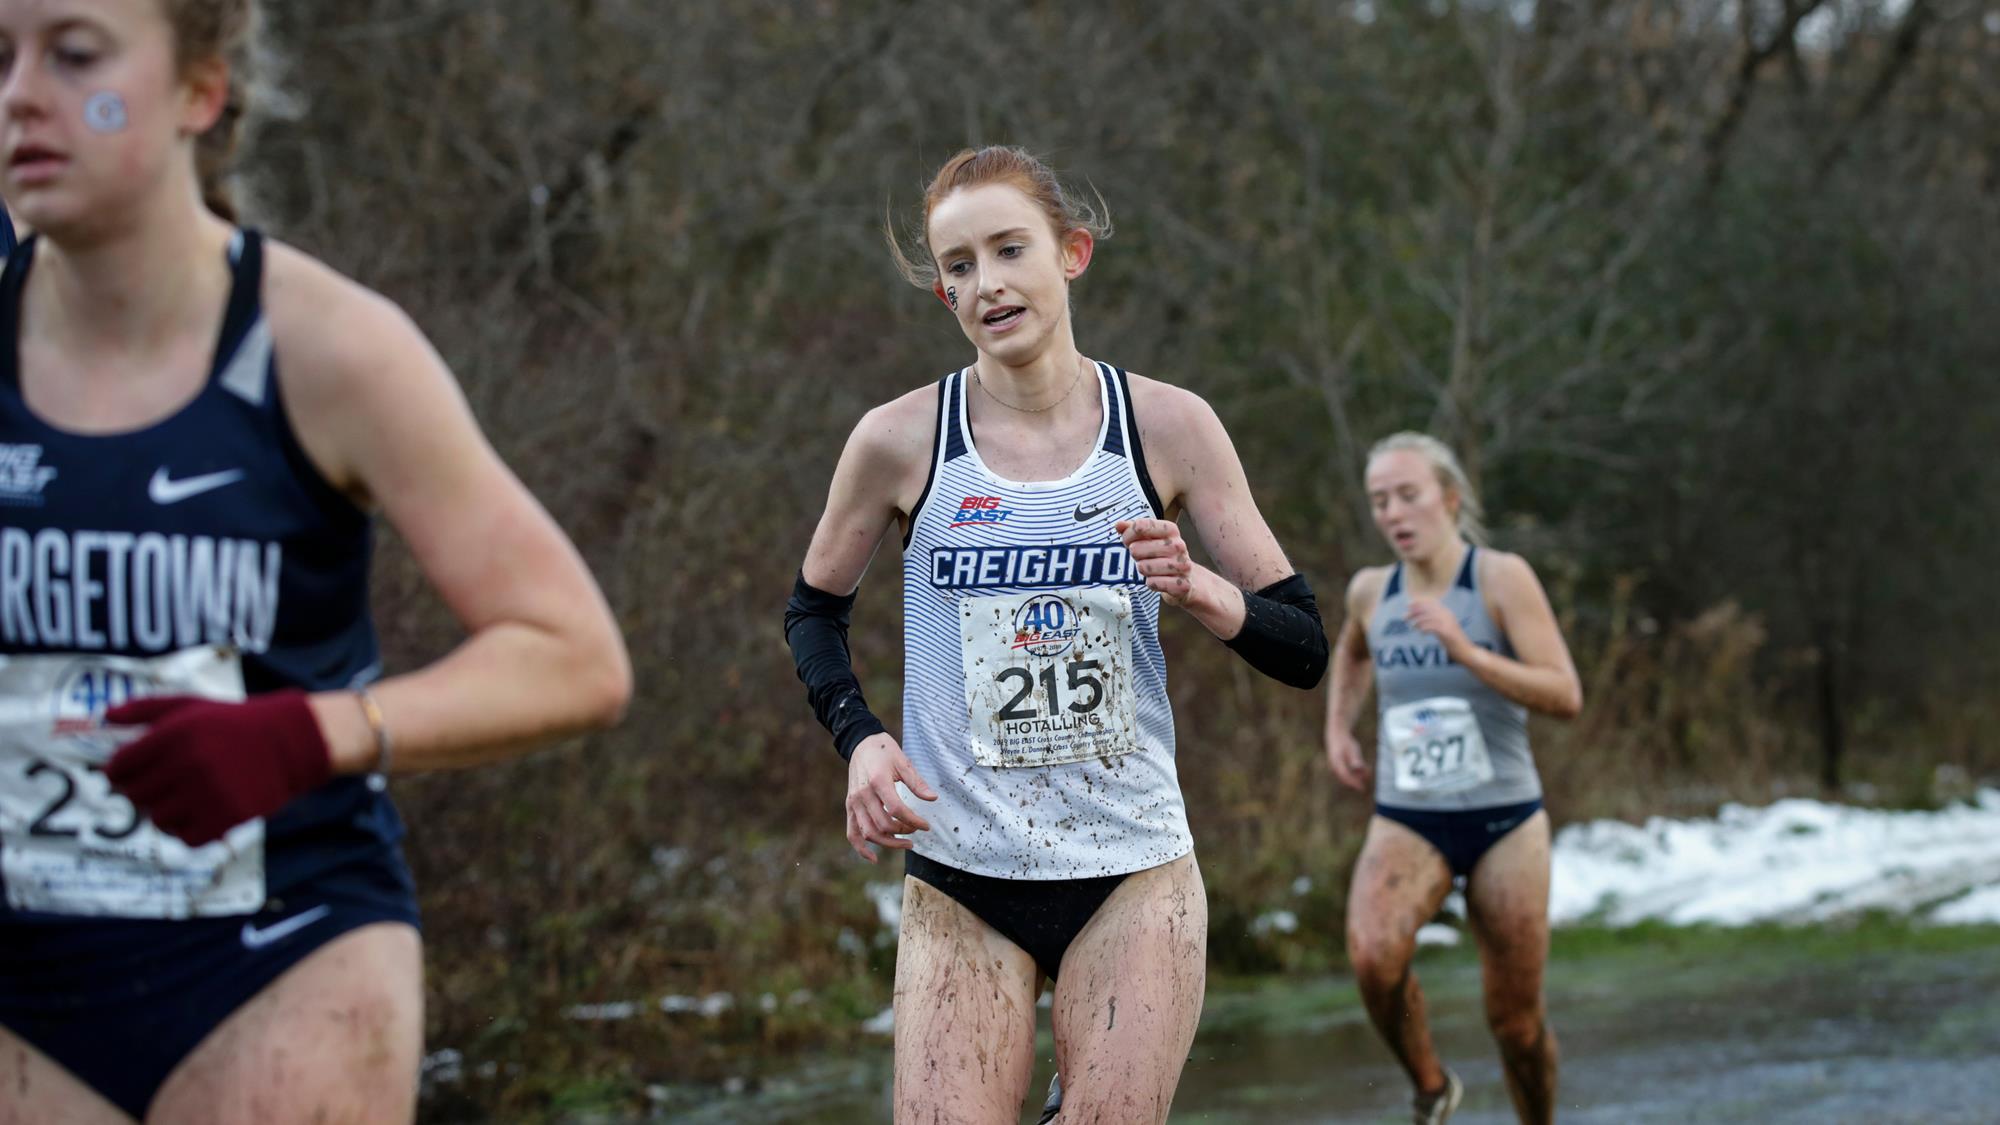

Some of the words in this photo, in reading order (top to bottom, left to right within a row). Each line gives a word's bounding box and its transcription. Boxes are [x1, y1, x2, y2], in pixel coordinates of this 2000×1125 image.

[960, 496, 1002, 509] BIG
[953, 509, 1013, 521] EAST
[0, 527, 281, 654] RGETOWN
[1024, 601, 1064, 631] 40
[1014, 631, 1041, 643] BIG
[1042, 628, 1081, 640] EAST
[996, 660, 1102, 721] 215
[1006, 713, 1100, 735] HOTALLING
[1010, 738, 1020, 746] BIG
[1021, 737, 1036, 745] EAST
[1053, 742, 1069, 751] Cross
[1402, 734, 1464, 777] 297
